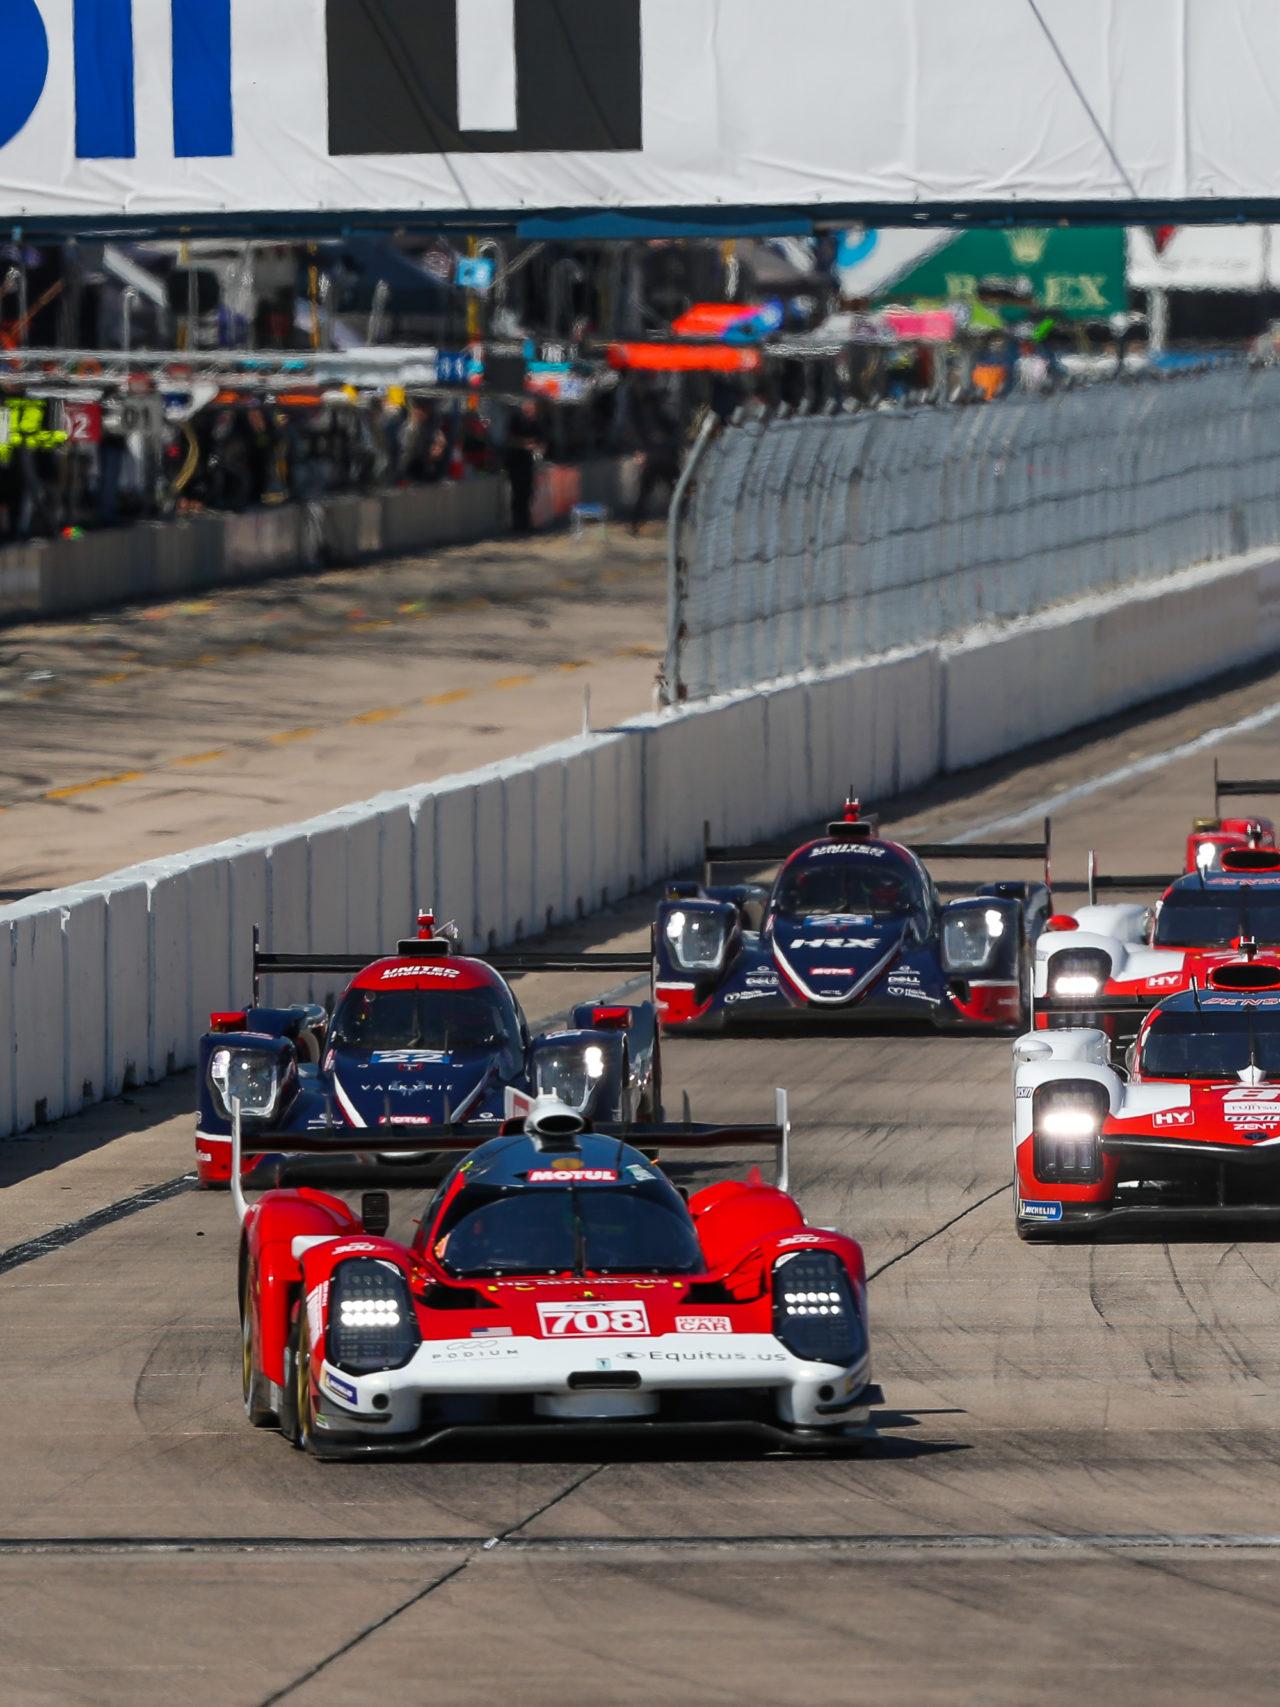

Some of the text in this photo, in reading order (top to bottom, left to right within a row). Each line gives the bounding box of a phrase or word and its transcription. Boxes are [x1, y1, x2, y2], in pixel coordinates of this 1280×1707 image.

[944, 272, 1107, 307] REX
[383, 965, 461, 976] UNITED
[1149, 976, 1180, 986] HY
[377, 1053, 444, 1063] 22
[361, 1084, 453, 1092] VALKYRIE
[1155, 1112, 1190, 1125] HY
[531, 1171, 616, 1181] MOTUL
[1024, 1206, 1057, 1216] MICHELIN
[543, 1310, 644, 1334] 708
[678, 1316, 728, 1324] HYPER
[679, 1323, 730, 1333] CAR
[432, 1349, 520, 1360] PODIUM
[649, 1351, 788, 1362] Equitus.us
